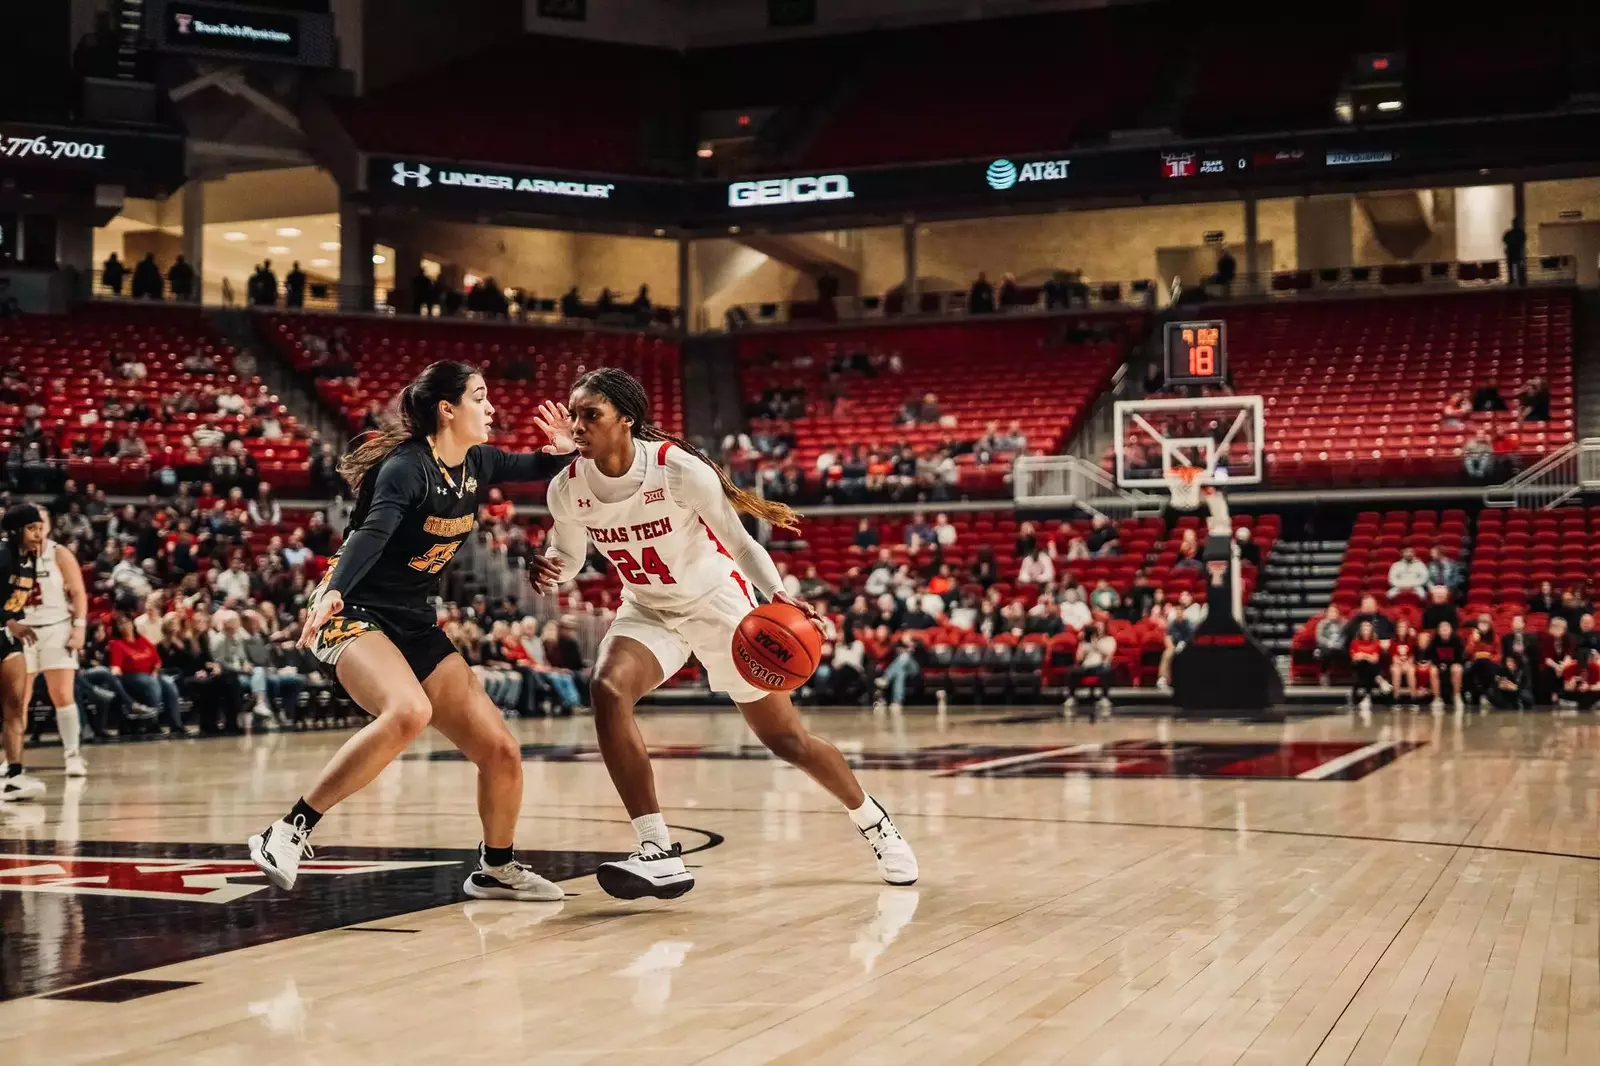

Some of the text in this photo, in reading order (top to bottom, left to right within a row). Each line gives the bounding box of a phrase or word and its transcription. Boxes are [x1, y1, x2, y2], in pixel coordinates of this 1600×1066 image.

[0, 133, 106, 160] .776.7001
[438, 171, 514, 190] UNDER
[1019, 160, 1070, 182] AT&T
[1189, 346, 1215, 376] 18
[586, 516, 673, 543] TEXAS TECH
[607, 546, 677, 585] 24
[754, 627, 795, 664] NCAA
[737, 643, 786, 687] Wilson
